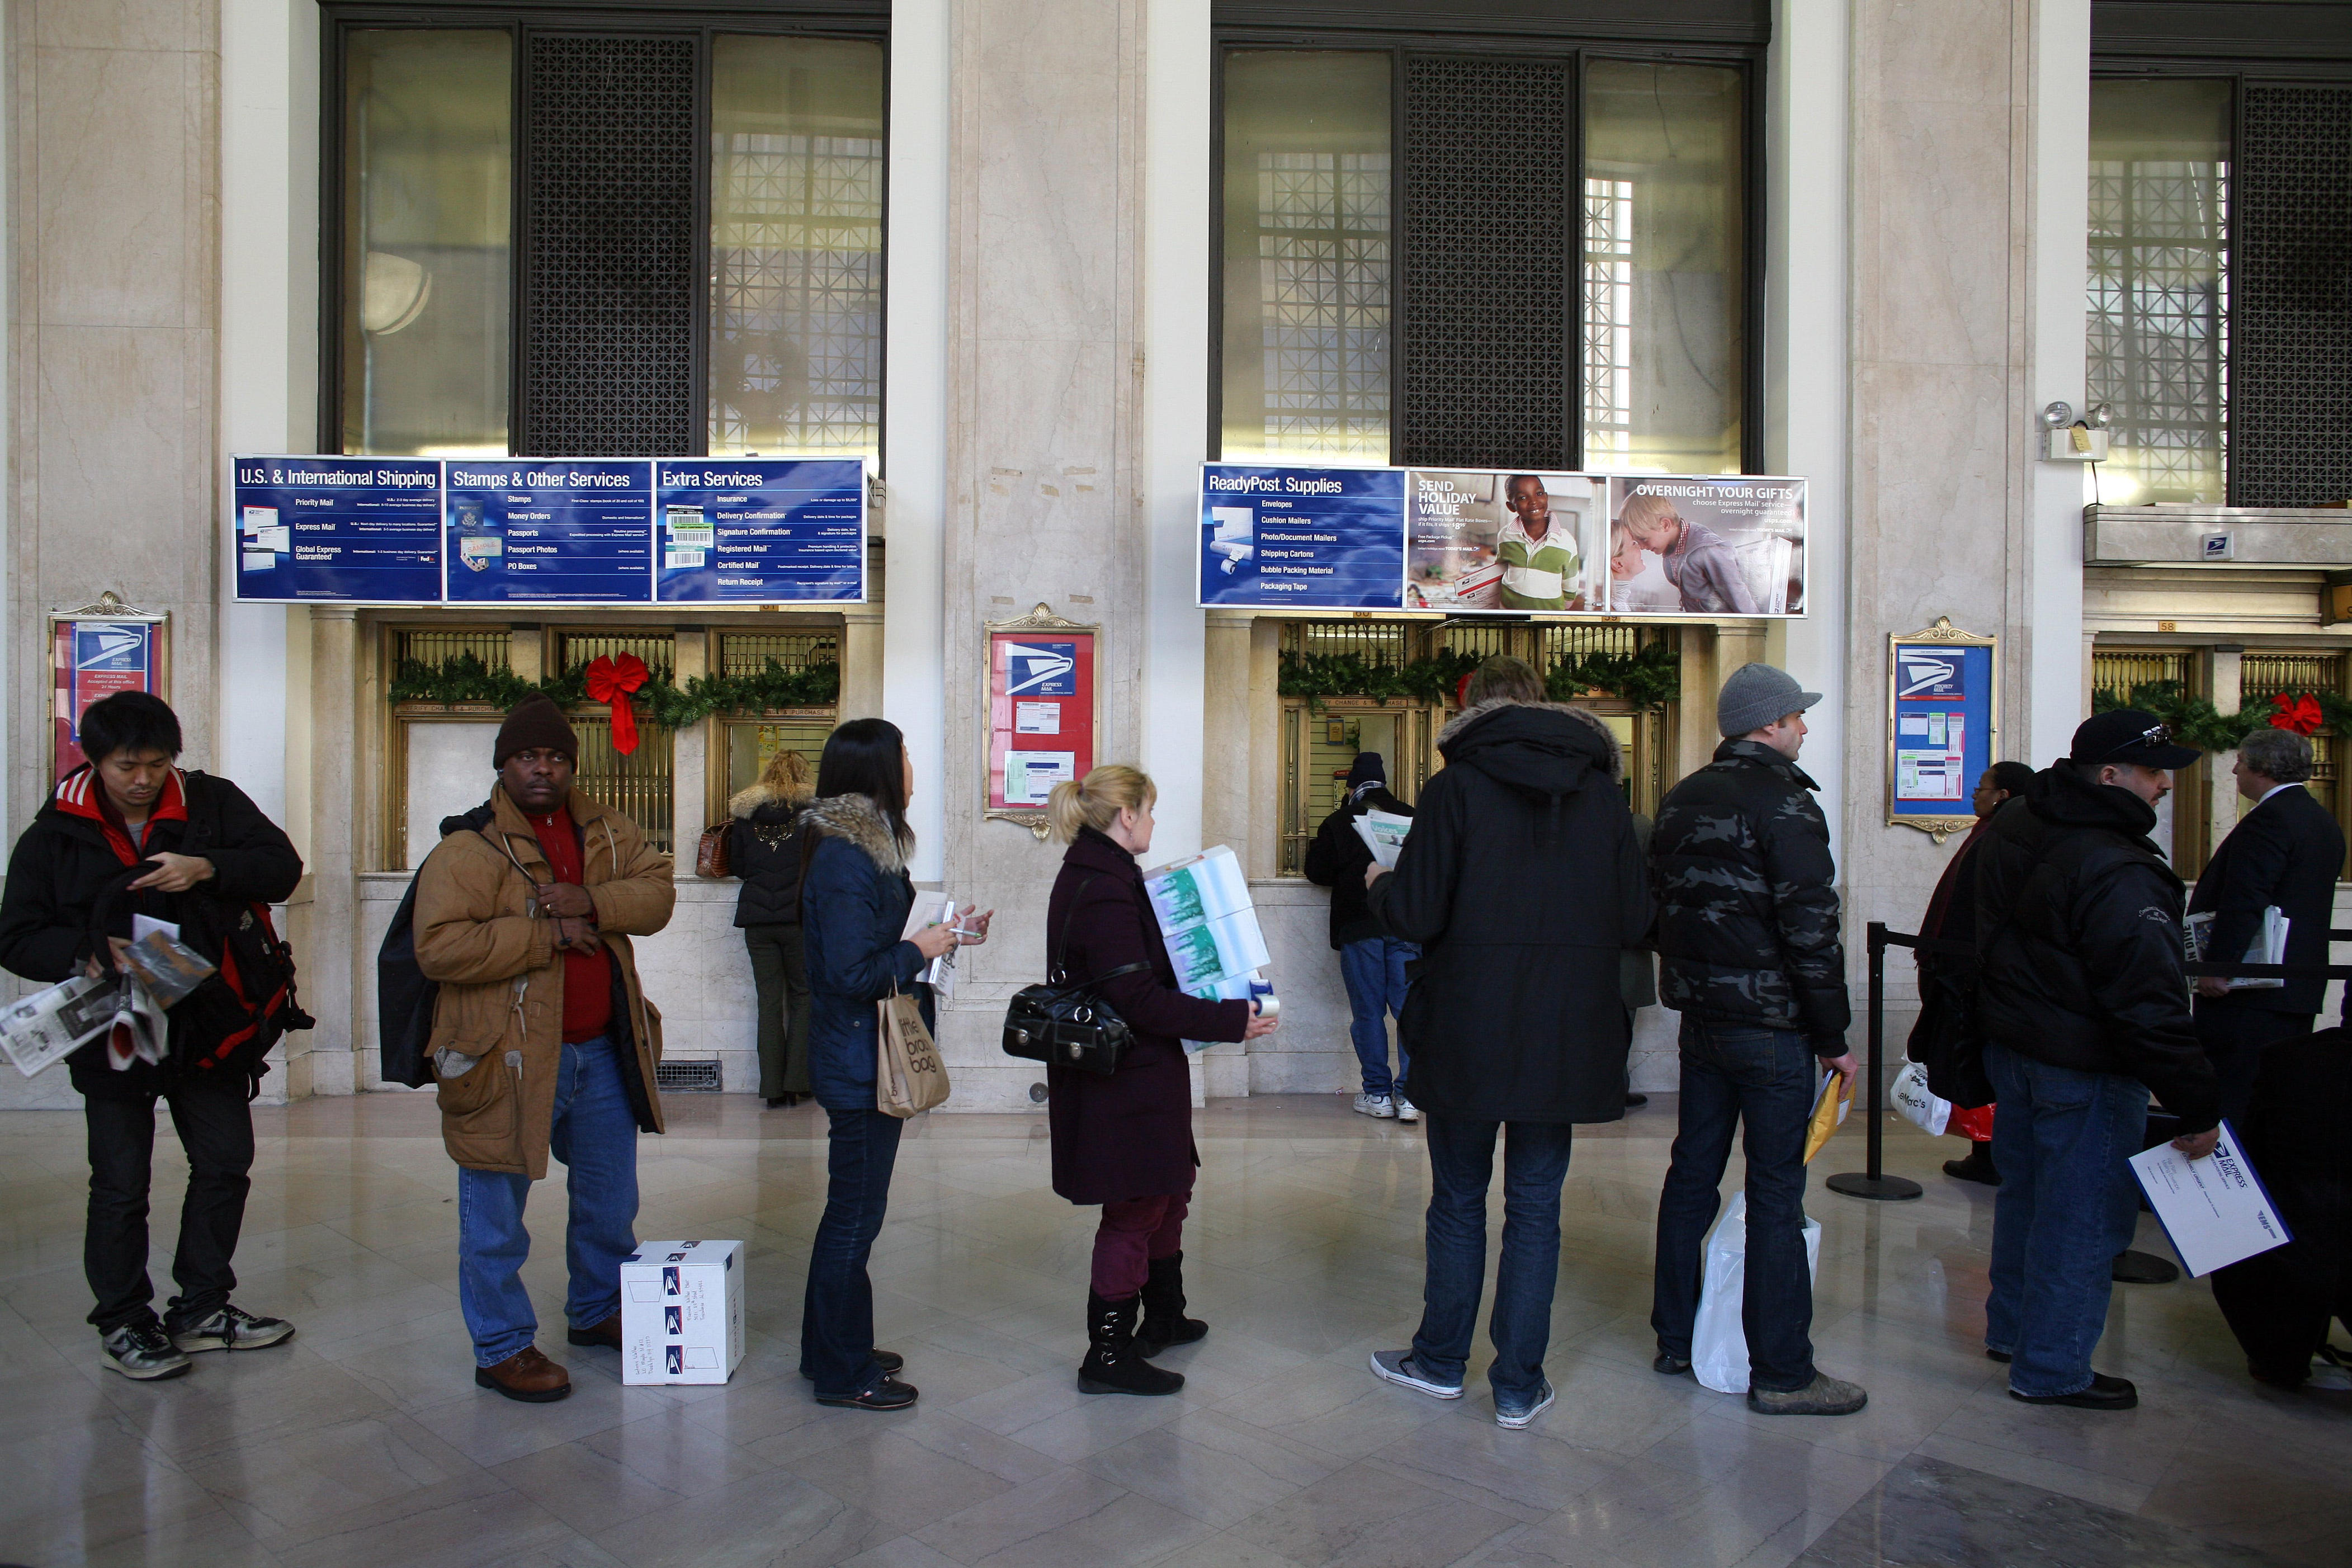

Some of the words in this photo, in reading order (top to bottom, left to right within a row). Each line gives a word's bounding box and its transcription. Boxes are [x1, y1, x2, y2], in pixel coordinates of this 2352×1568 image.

[241, 469, 267, 484] U.S.
[272, 469, 284, 484] &
[288, 469, 373, 485] International
[377, 470, 436, 489] Shipping
[454, 471, 508, 489] Stamps
[512, 471, 523, 487] &
[527, 472, 565, 487] Other
[569, 472, 630, 487] Services
[663, 471, 700, 487] Extra
[703, 471, 763, 487] Services
[1286, 478, 1342, 495] Supplies
[1418, 480, 1454, 492] SEND
[1636, 484, 1715, 498] OVERNIGHT
[1717, 487, 1753, 498] YOUR
[1756, 488, 1793, 499] GIFTS
[295, 499, 318, 507] Priority
[508, 495, 532, 504] Stamps
[1418, 492, 1476, 504] HOLIDAY
[1262, 500, 1292, 509] Envelopes
[1418, 504, 1460, 516] VALUE
[717, 512, 743, 521] Delivery
[717, 528, 748, 537] Signature
[1261, 533, 1312, 541] Photo/Document
[717, 545, 752, 554] Registered
[1260, 550, 1288, 559] Shipping
[1283, 566, 1307, 575] Packing
[1260, 583, 1292, 592] Packaging
[1293, 583, 1307, 591] Tape
[2161, 622, 2174, 631] 58
[1371, 824, 1399, 834] Voices
[2183, 924, 2195, 950] DIVE
[909, 1056, 937, 1073] bag
[2218, 1159, 2233, 1178] MAIL
[2226, 1158, 2248, 1189] EXPRESS
[2257, 1215, 2271, 1230] EMS
